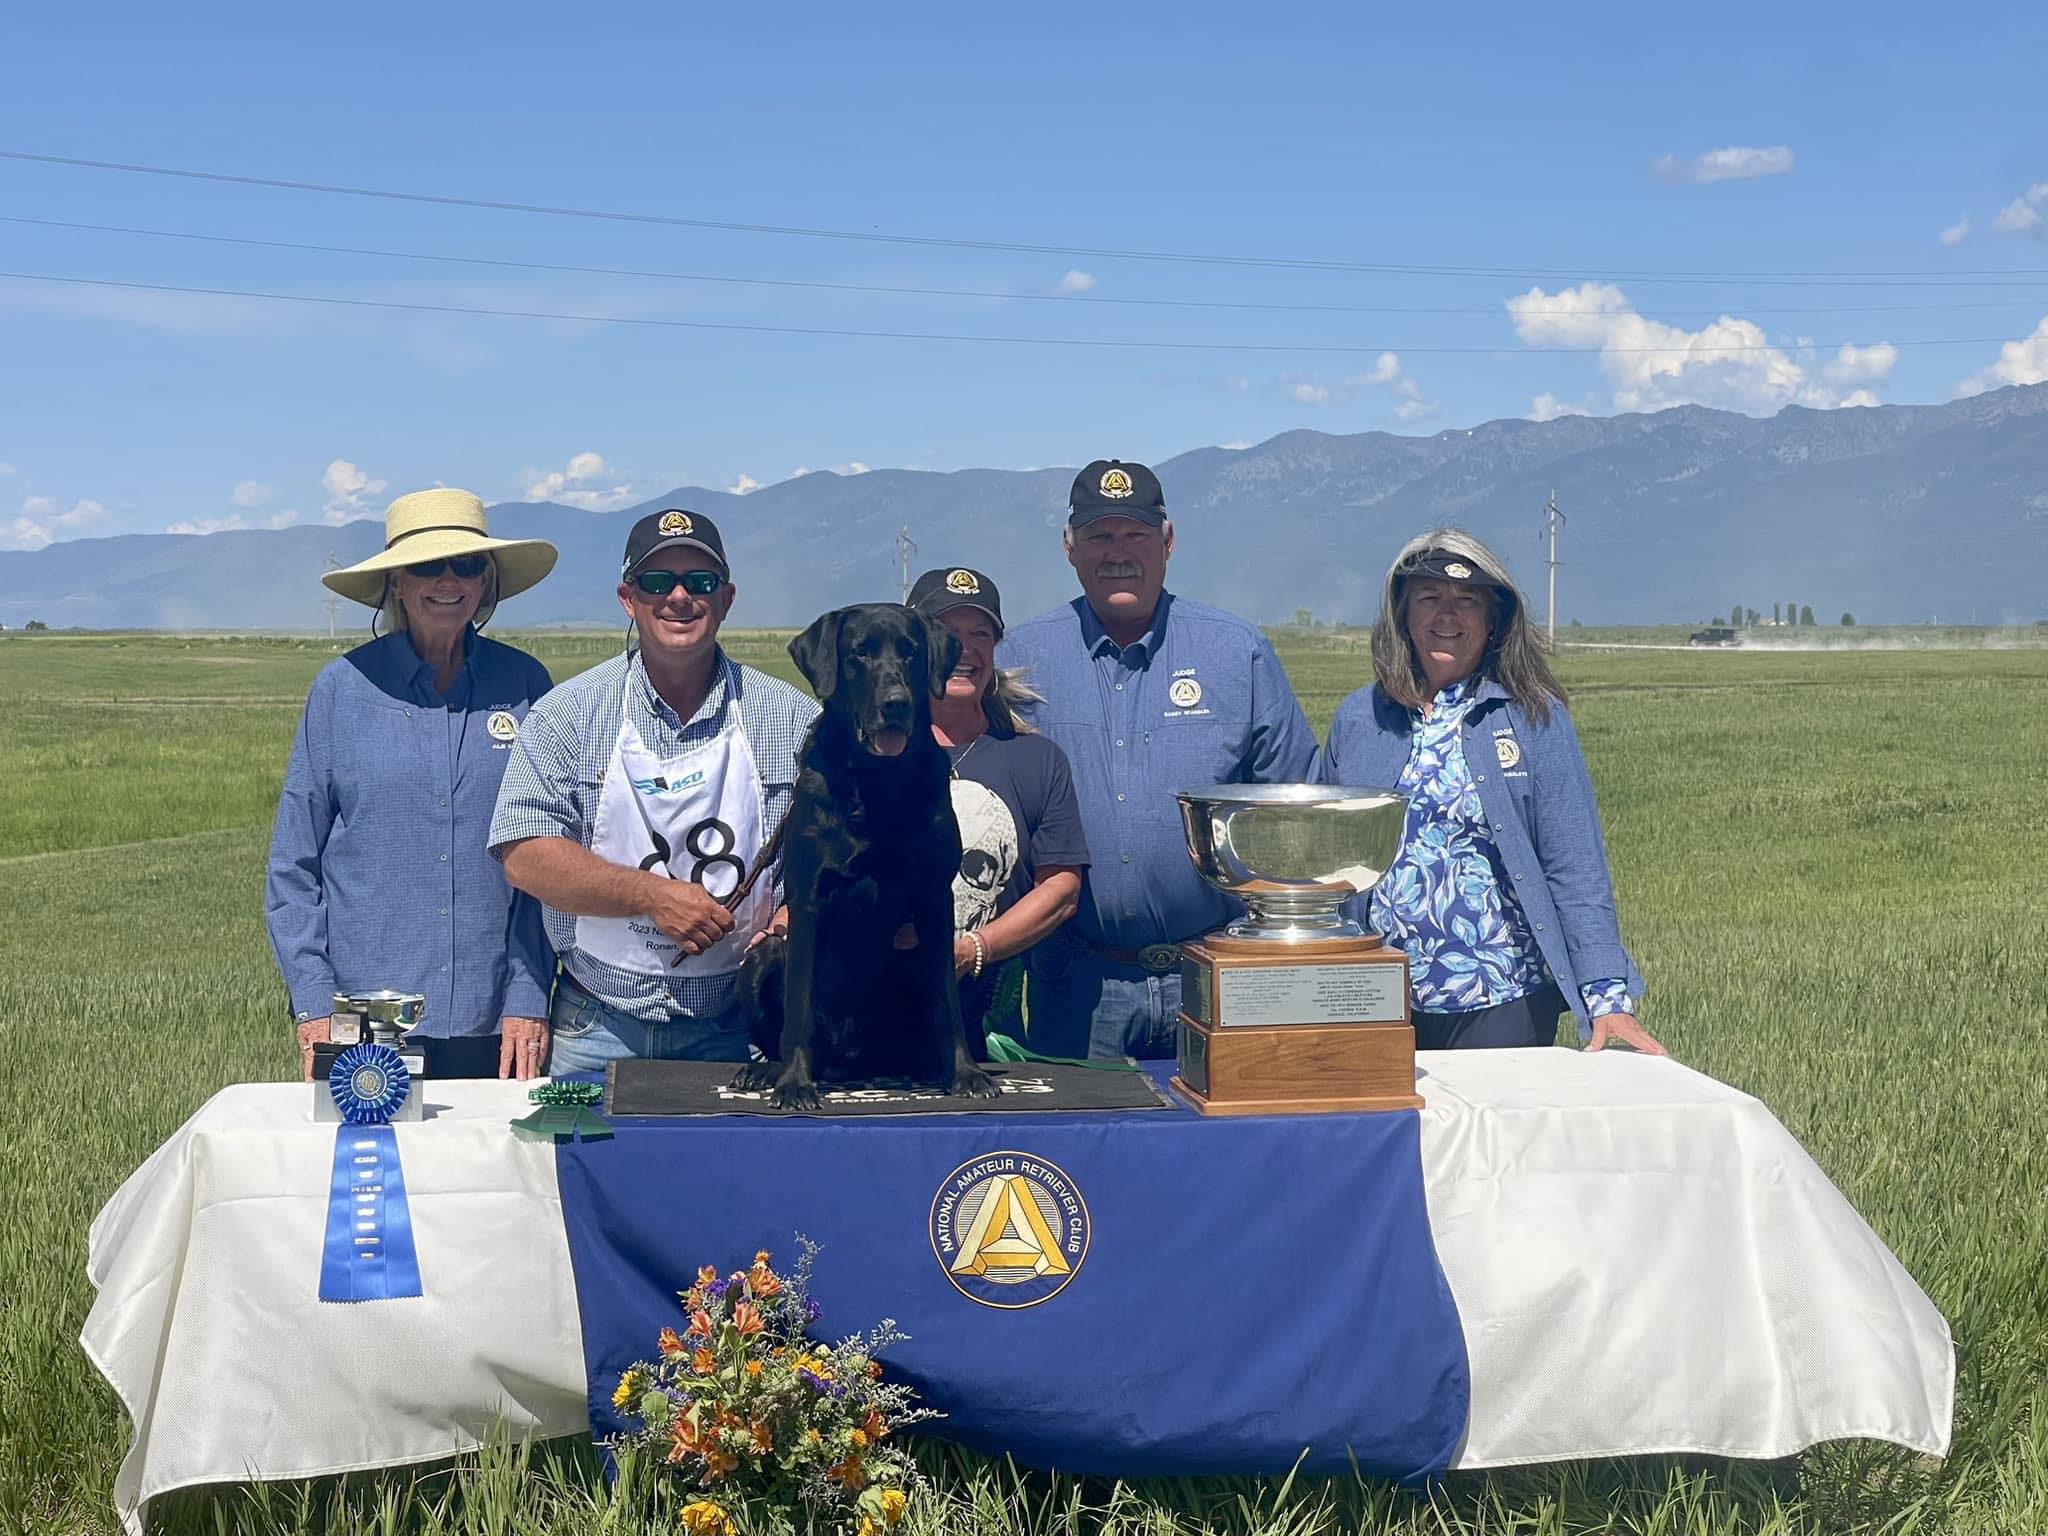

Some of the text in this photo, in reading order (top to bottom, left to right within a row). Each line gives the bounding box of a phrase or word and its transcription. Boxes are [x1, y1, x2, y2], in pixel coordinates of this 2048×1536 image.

[1172, 668, 1196, 677] JUDGE
[628, 921, 650, 935] 2023
[646, 940, 680, 951] Ronan,
[938, 1159, 1083, 1253] NATIONAL AMATEUR RETRIEVER CLUB
